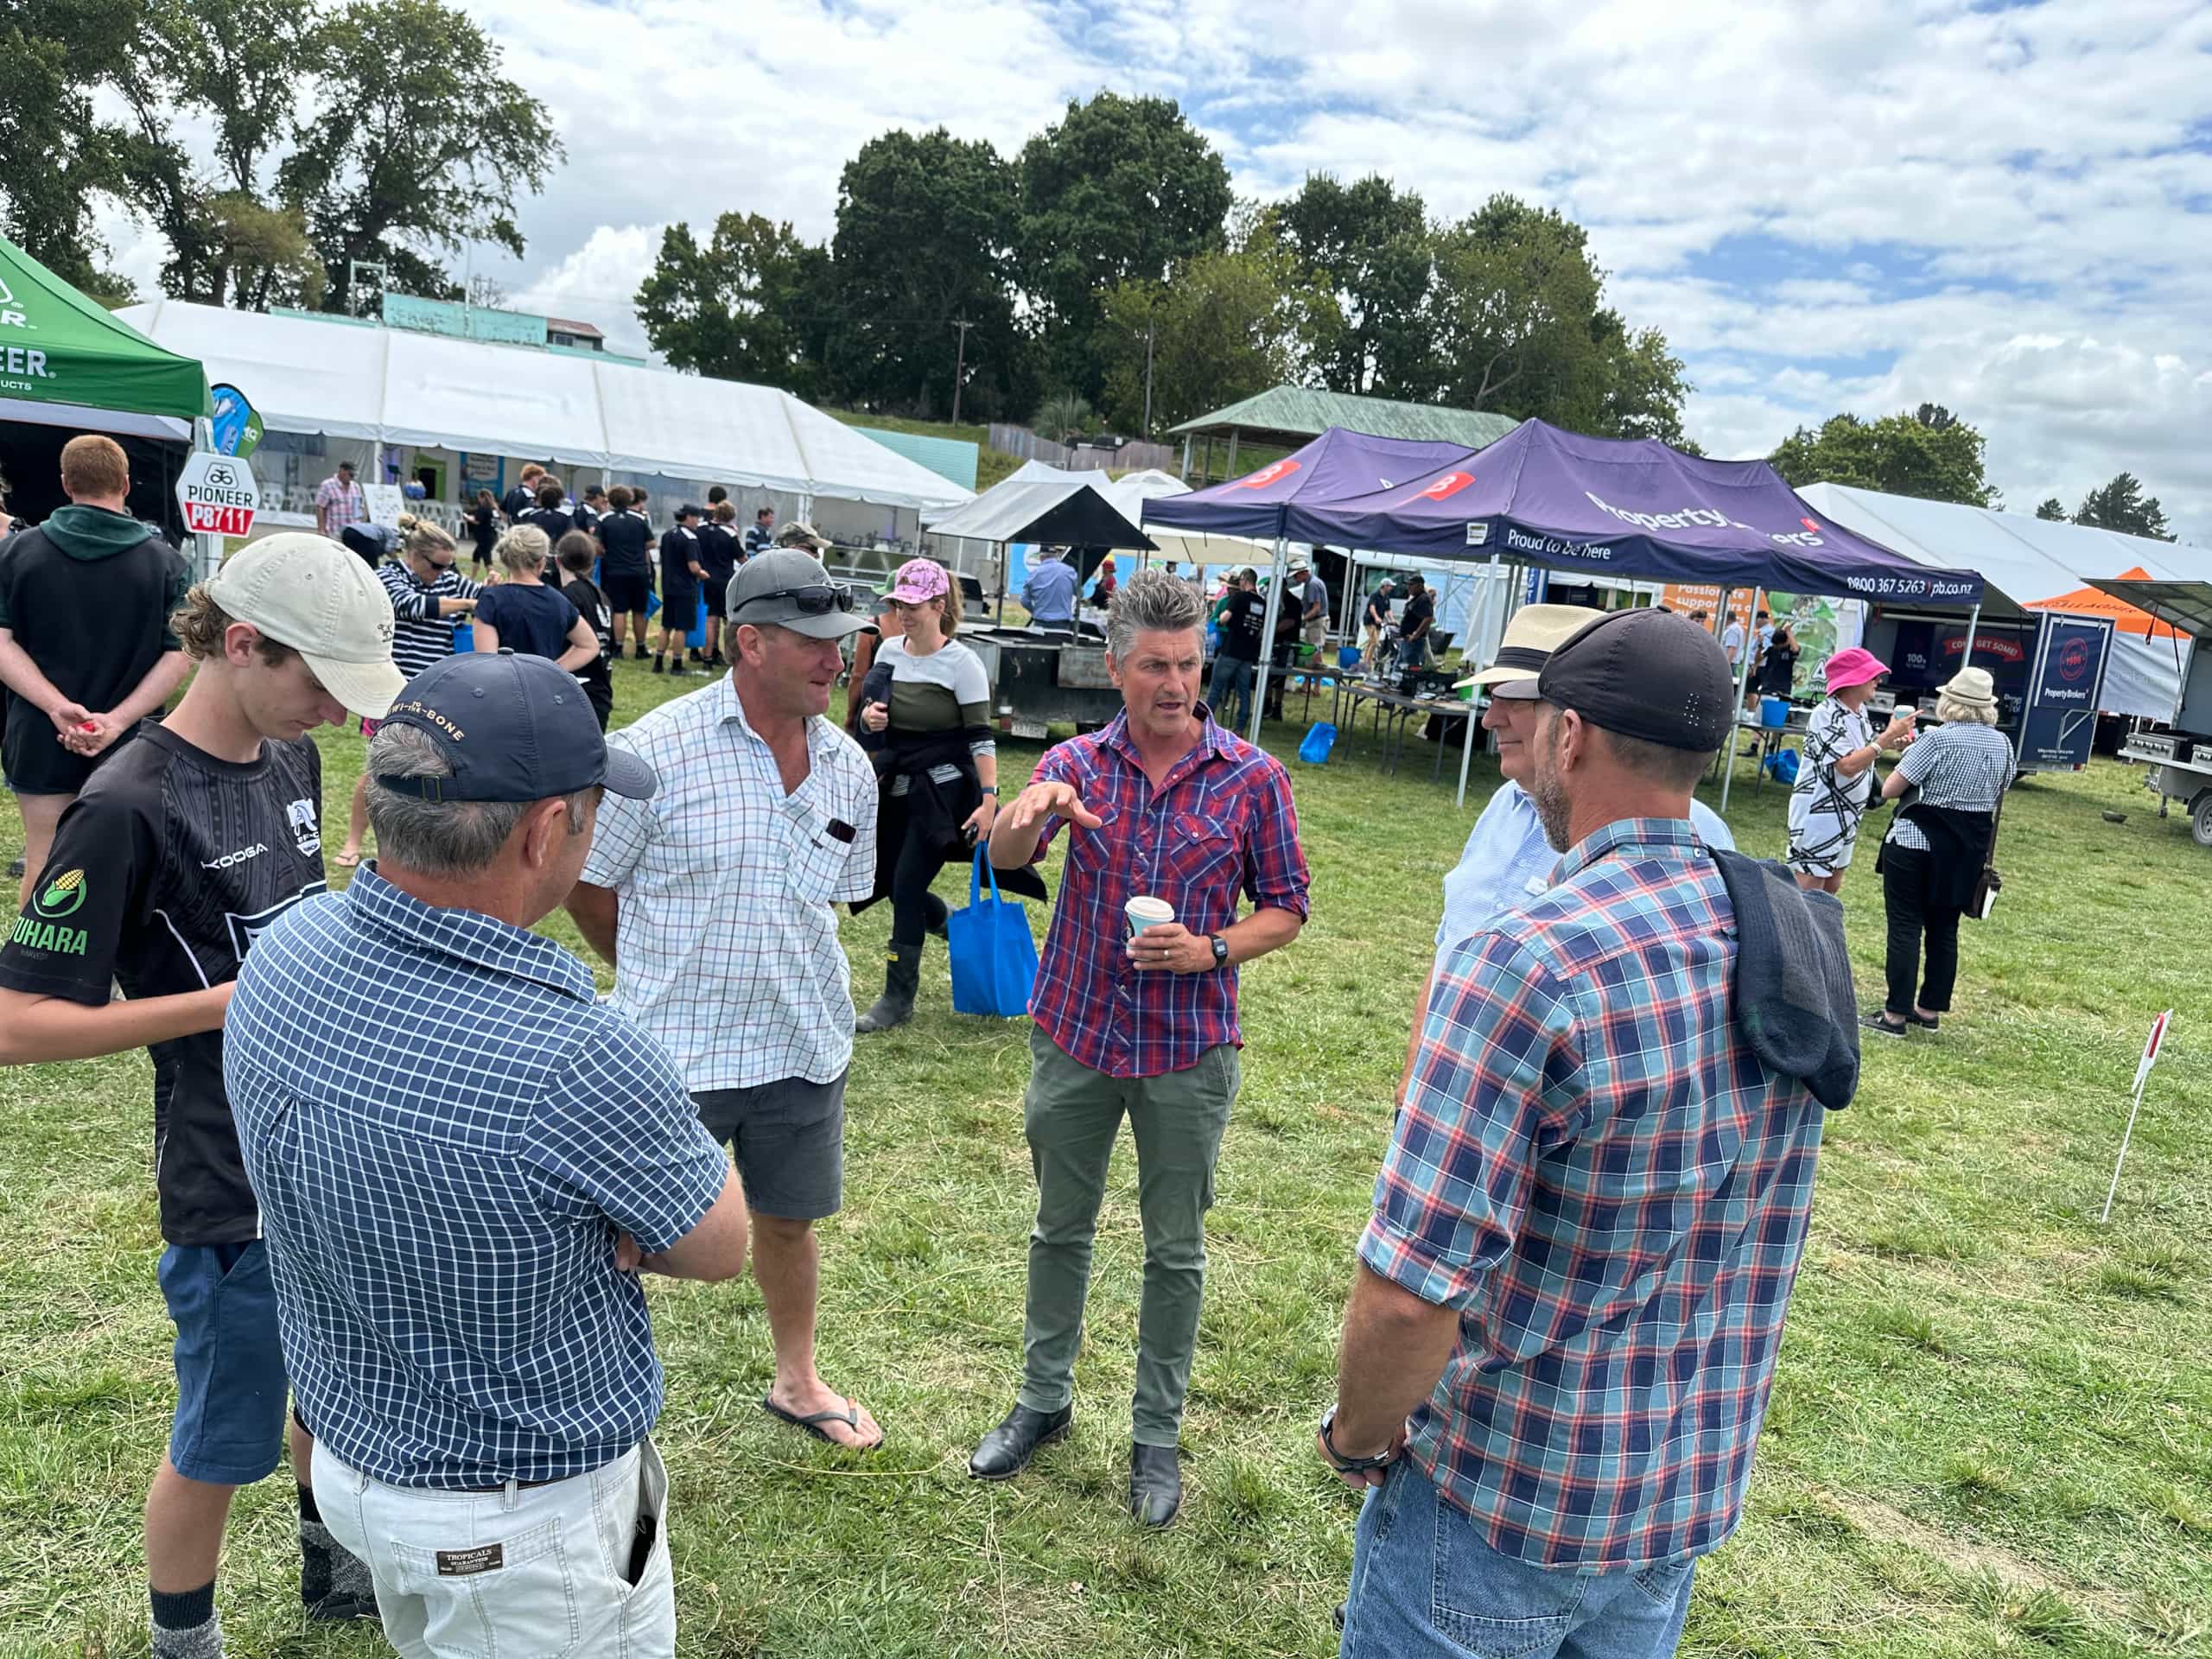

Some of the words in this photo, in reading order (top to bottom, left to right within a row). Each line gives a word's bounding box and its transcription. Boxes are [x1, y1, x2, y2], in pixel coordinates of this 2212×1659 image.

[188, 485, 252, 507] PIONEER
[191, 505, 245, 533] P8711
[1508, 529, 1546, 551] Proud
[1546, 537, 1560, 553] to
[1562, 540, 1580, 556] be
[1581, 543, 1611, 560] here
[1847, 576, 1875, 593] 0800
[1877, 578, 1896, 593] 367
[1897, 580, 1925, 594] 5263
[1929, 581, 1974, 597] pb.co.nz
[1976, 639, 1992, 649] GET
[1993, 642, 2018, 657] SOME!
[200, 842, 269, 869] KOOGA
[447, 1548, 493, 1561] TROPICALS
